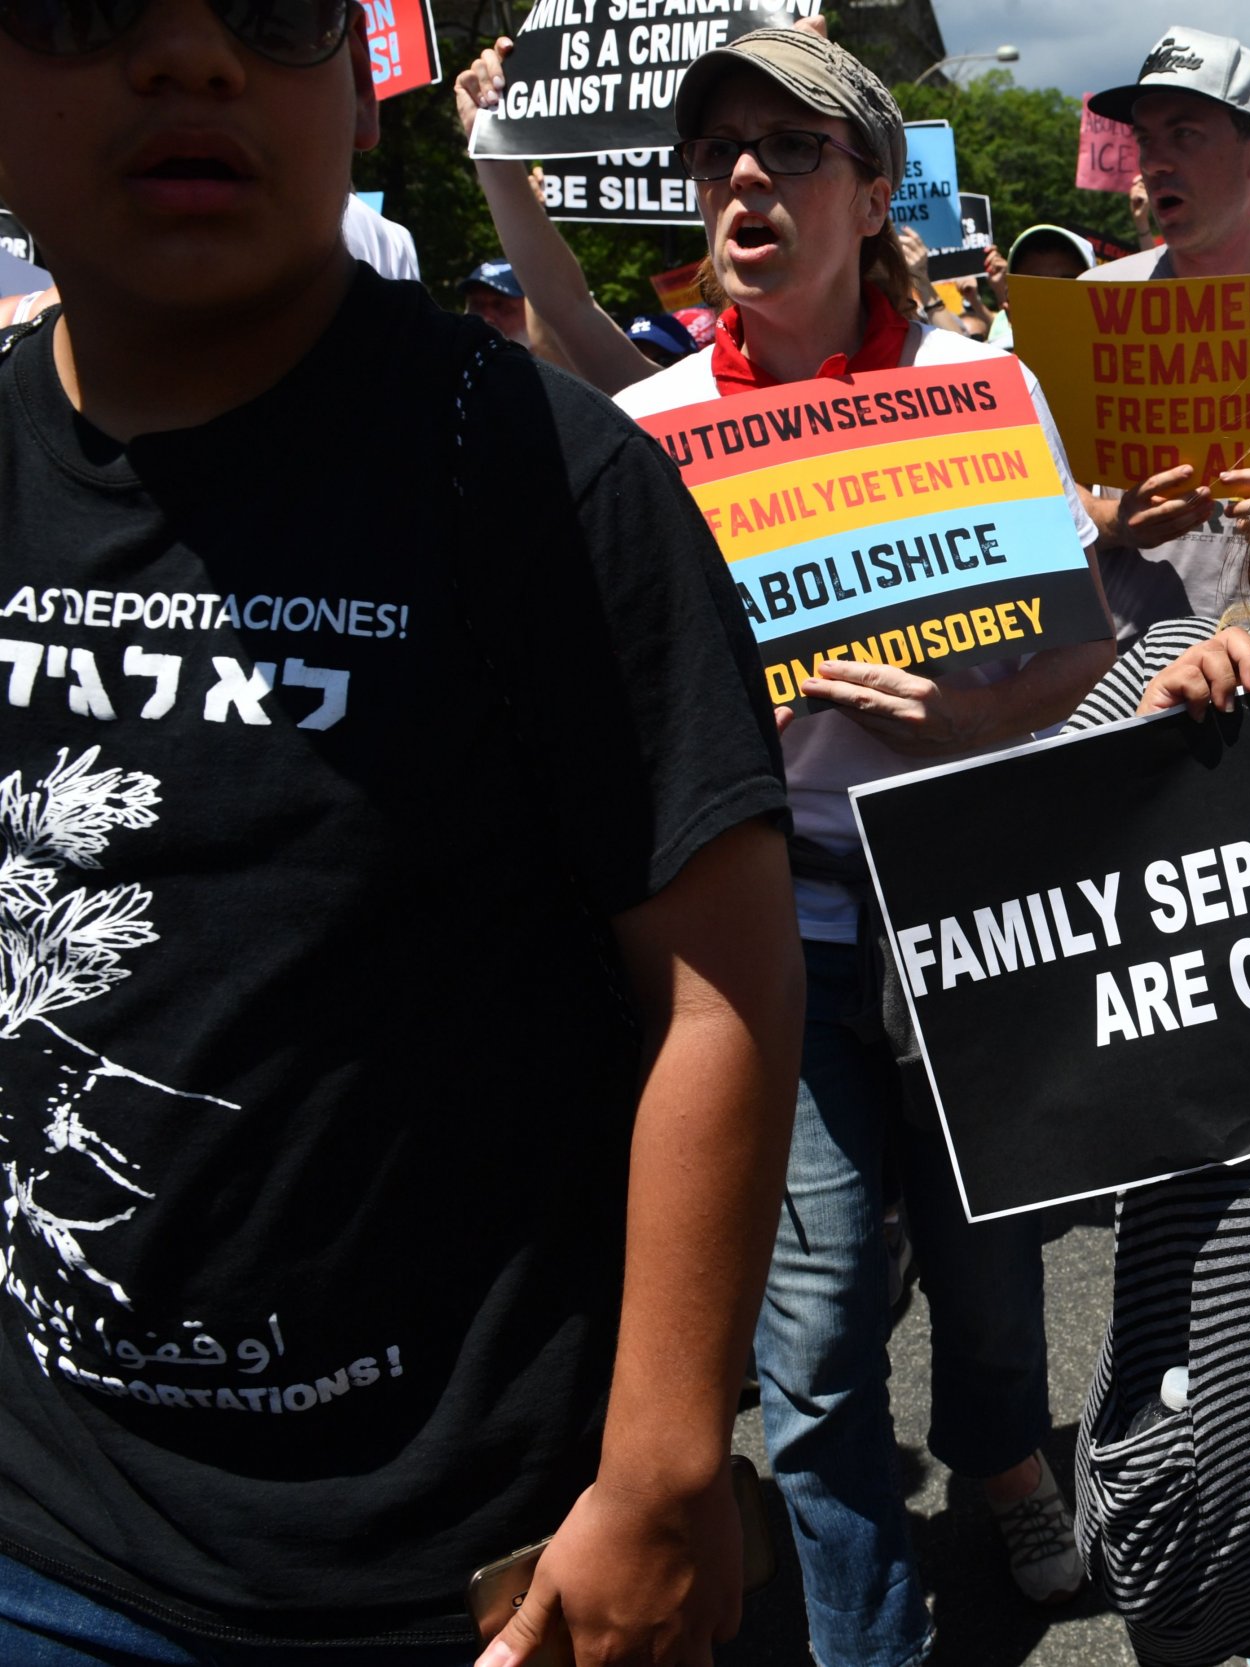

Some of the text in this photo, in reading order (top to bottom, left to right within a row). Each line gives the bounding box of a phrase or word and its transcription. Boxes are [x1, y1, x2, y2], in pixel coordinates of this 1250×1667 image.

[561, 20, 729, 70] IS A CRIME
[629, 69, 688, 110] HU
[1090, 142, 1133, 172] ICE
[543, 175, 588, 209] BE
[657, 380, 997, 467] UTDOWNSESSIONS
[1095, 438, 1180, 484] FOR
[736, 523, 1007, 624] ABOLISHICE
[0, 586, 408, 639] AS DEPORTACIONES!
[203, 656, 350, 731] לא
[897, 872, 1121, 998] FAMILY
[1096, 950, 1217, 1047] ARE
